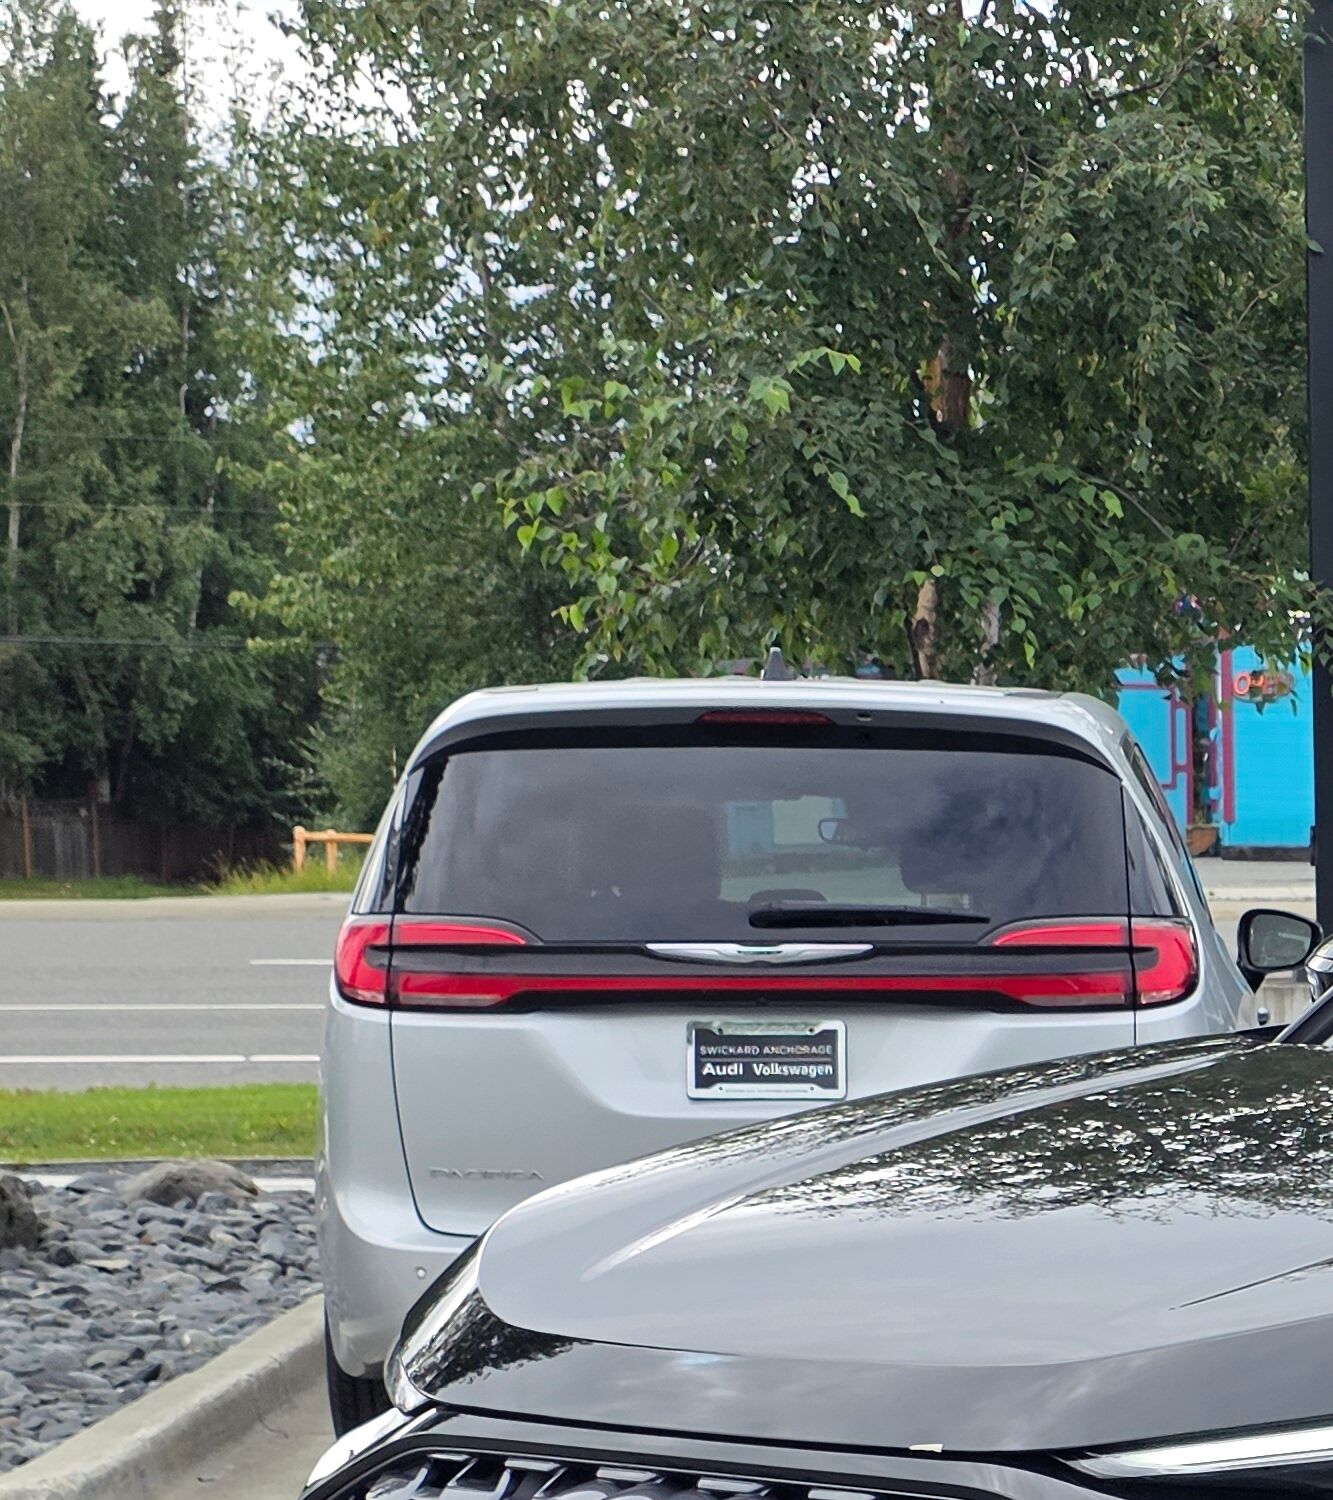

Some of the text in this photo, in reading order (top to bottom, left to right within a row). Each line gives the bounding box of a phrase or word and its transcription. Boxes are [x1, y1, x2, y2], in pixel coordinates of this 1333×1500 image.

[699, 1045, 833, 1056] SWICKARD ANCHORAGE
[702, 1062, 833, 1078] Audi Volkswagen
